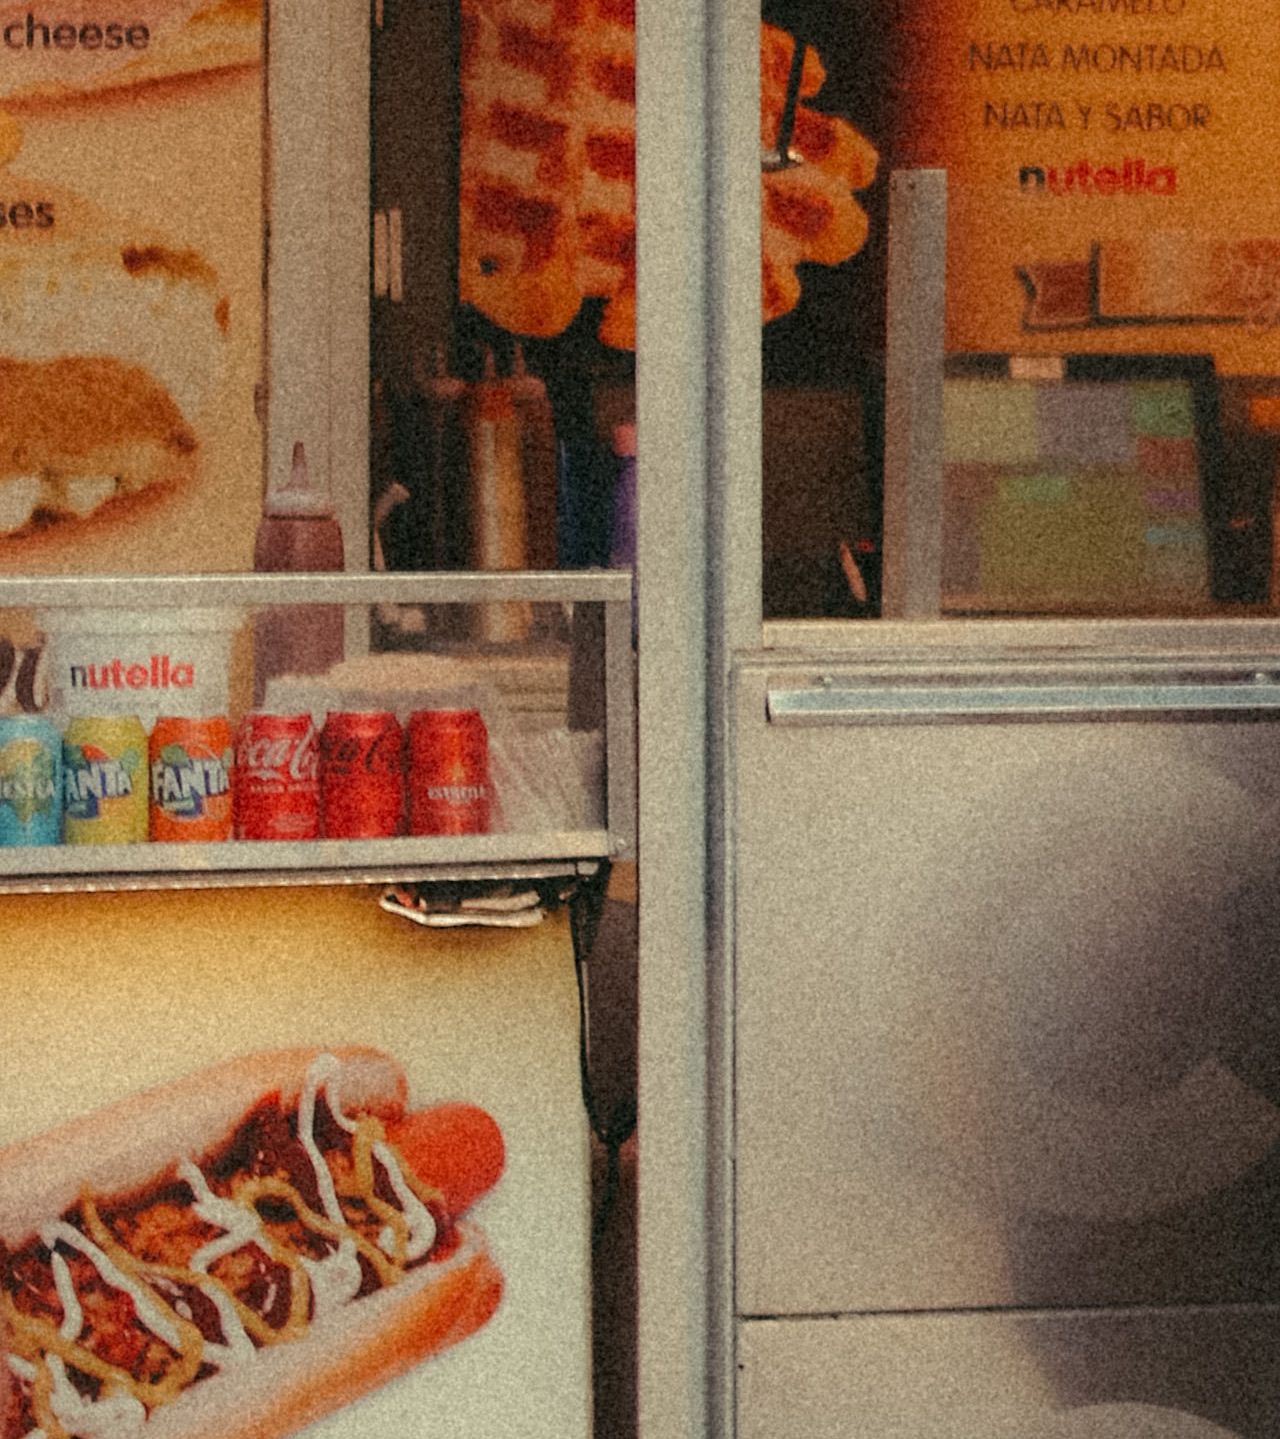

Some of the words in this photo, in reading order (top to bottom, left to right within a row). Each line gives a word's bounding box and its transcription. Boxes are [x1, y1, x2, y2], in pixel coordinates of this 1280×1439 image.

[4, 13, 150, 50] cheese
[967, 42, 1049, 73] NATA
[1061, 43, 1227, 74] MONTADA
[984, 101, 1065, 132] NATA
[1076, 102, 1092, 132] Y
[1105, 103, 1212, 134] SABOR
[1019, 158, 1177, 195] nutella
[0, 202, 54, 228] es
[70, 654, 195, 691] nutella
[65, 761, 132, 801] ANTA
